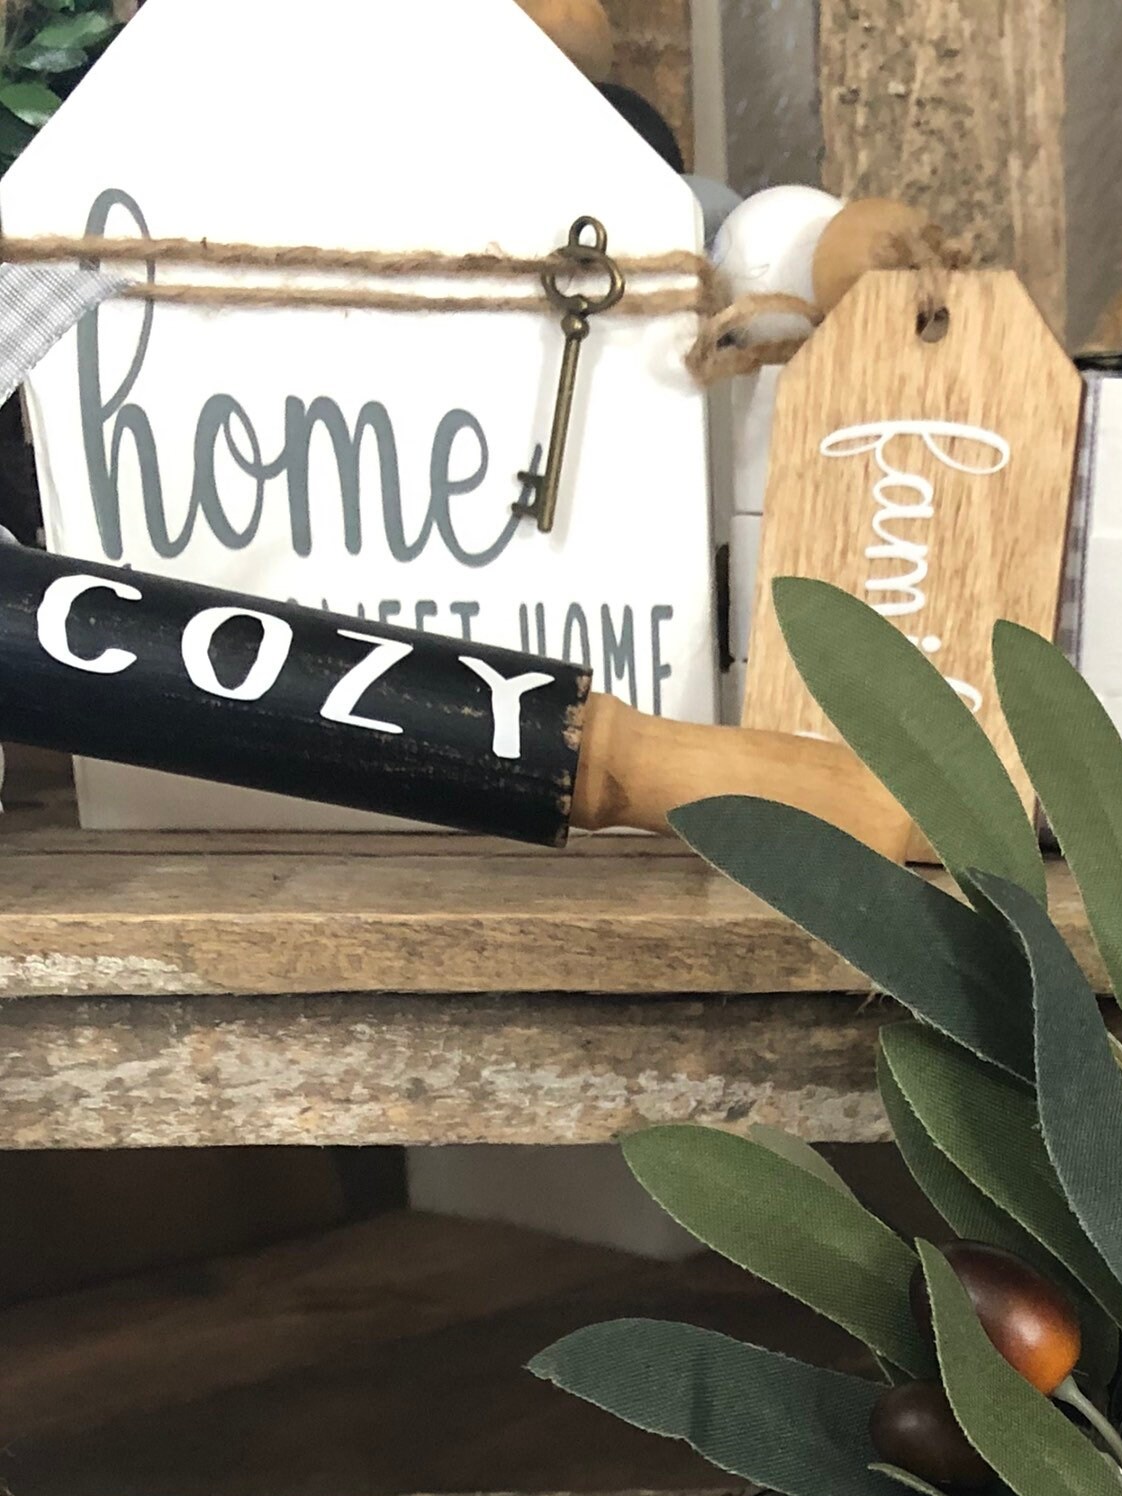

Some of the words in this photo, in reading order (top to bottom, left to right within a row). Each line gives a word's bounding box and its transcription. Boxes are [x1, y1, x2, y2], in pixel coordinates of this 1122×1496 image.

[77, 188, 544, 568] home
[37, 573, 556, 759] COZY
[795, 419, 1011, 738] fam
